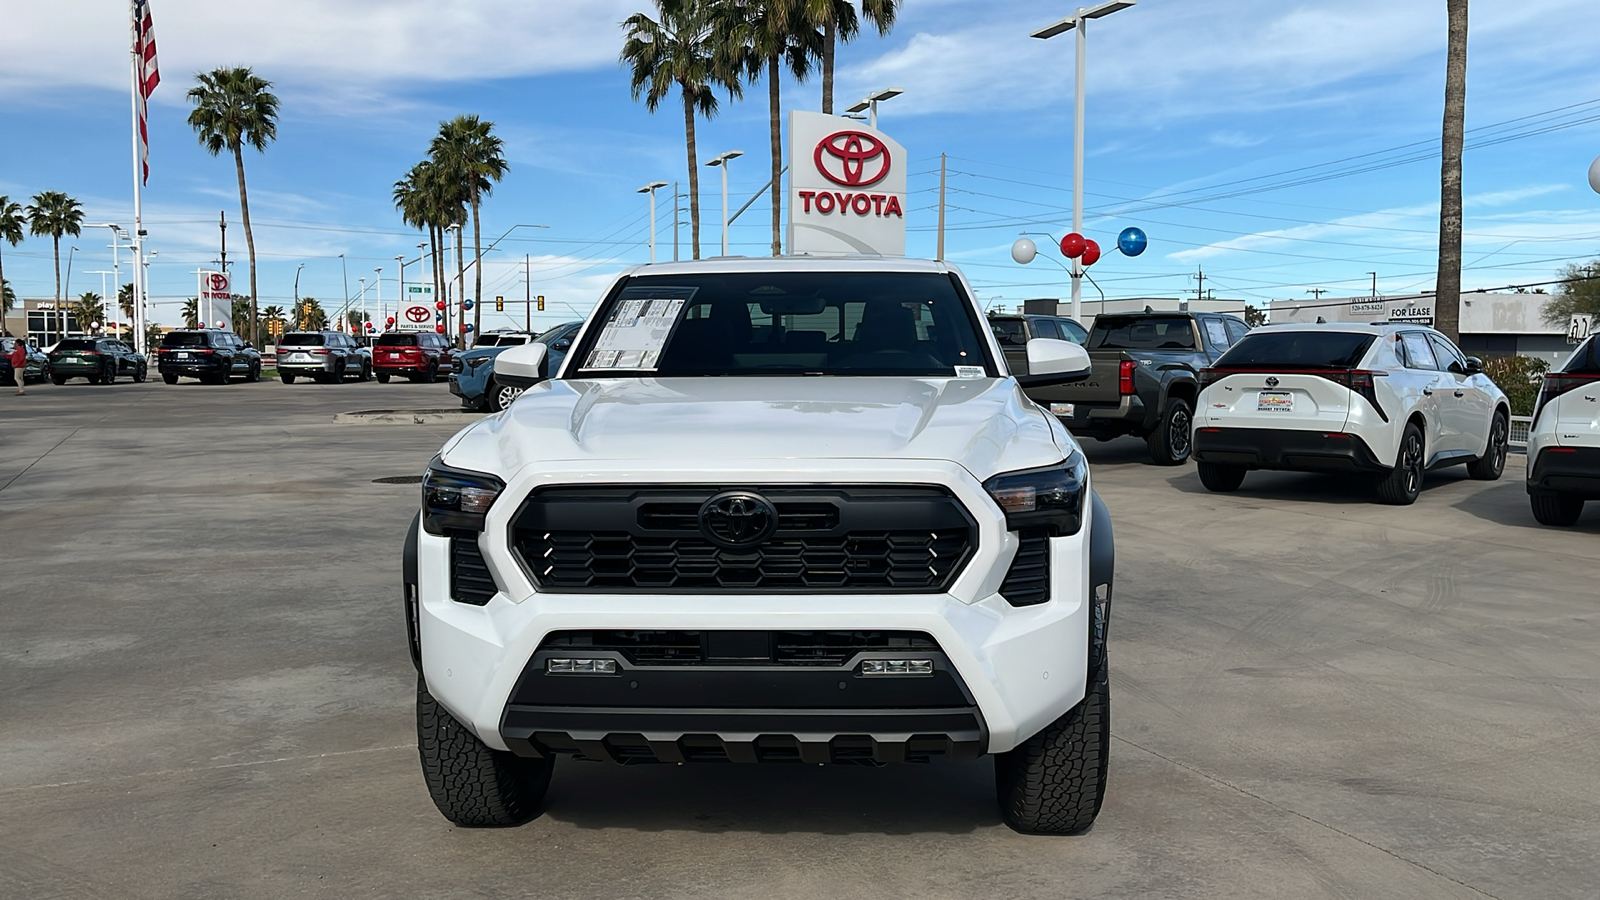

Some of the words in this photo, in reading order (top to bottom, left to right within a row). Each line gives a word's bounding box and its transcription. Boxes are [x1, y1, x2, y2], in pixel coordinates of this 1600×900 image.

[799, 191, 902, 217] TOYOTA
[1391, 308, 1407, 317] FOR
[1408, 308, 1430, 316] LEASE
